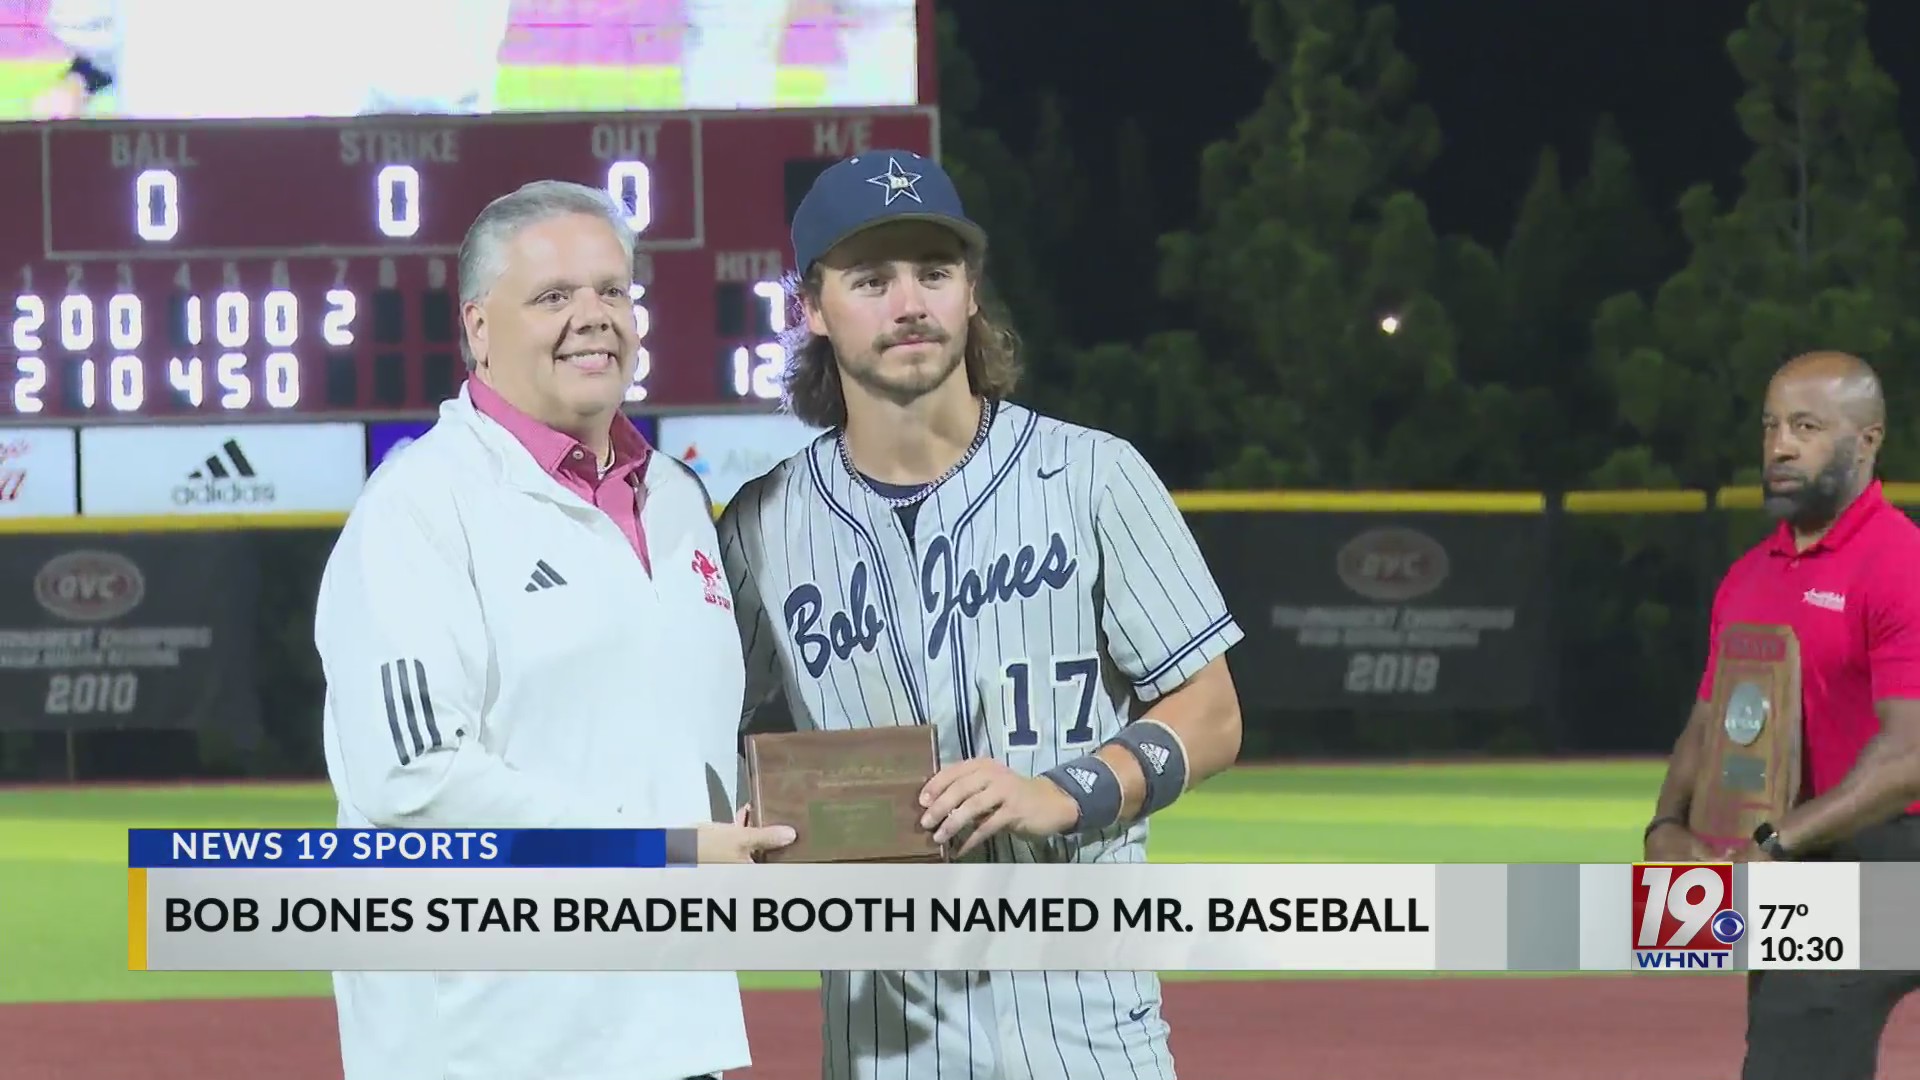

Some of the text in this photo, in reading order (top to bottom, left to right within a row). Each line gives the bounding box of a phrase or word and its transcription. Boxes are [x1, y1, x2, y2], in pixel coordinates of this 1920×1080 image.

[111, 133, 196, 166] BALL
[339, 130, 459, 164] STRIKE
[591, 124, 661, 156] OUT
[813, 120, 872, 154] H/E
[136, 170, 179, 241] 0
[378, 165, 420, 237] 0
[714, 252, 782, 282] HITS
[171, 481, 276, 507] adidas
[783, 530, 1078, 680] Bob Jones
[1344, 653, 1440, 693] 2019
[45, 671, 139, 714] 2010
[1004, 656, 1100, 749] 17
